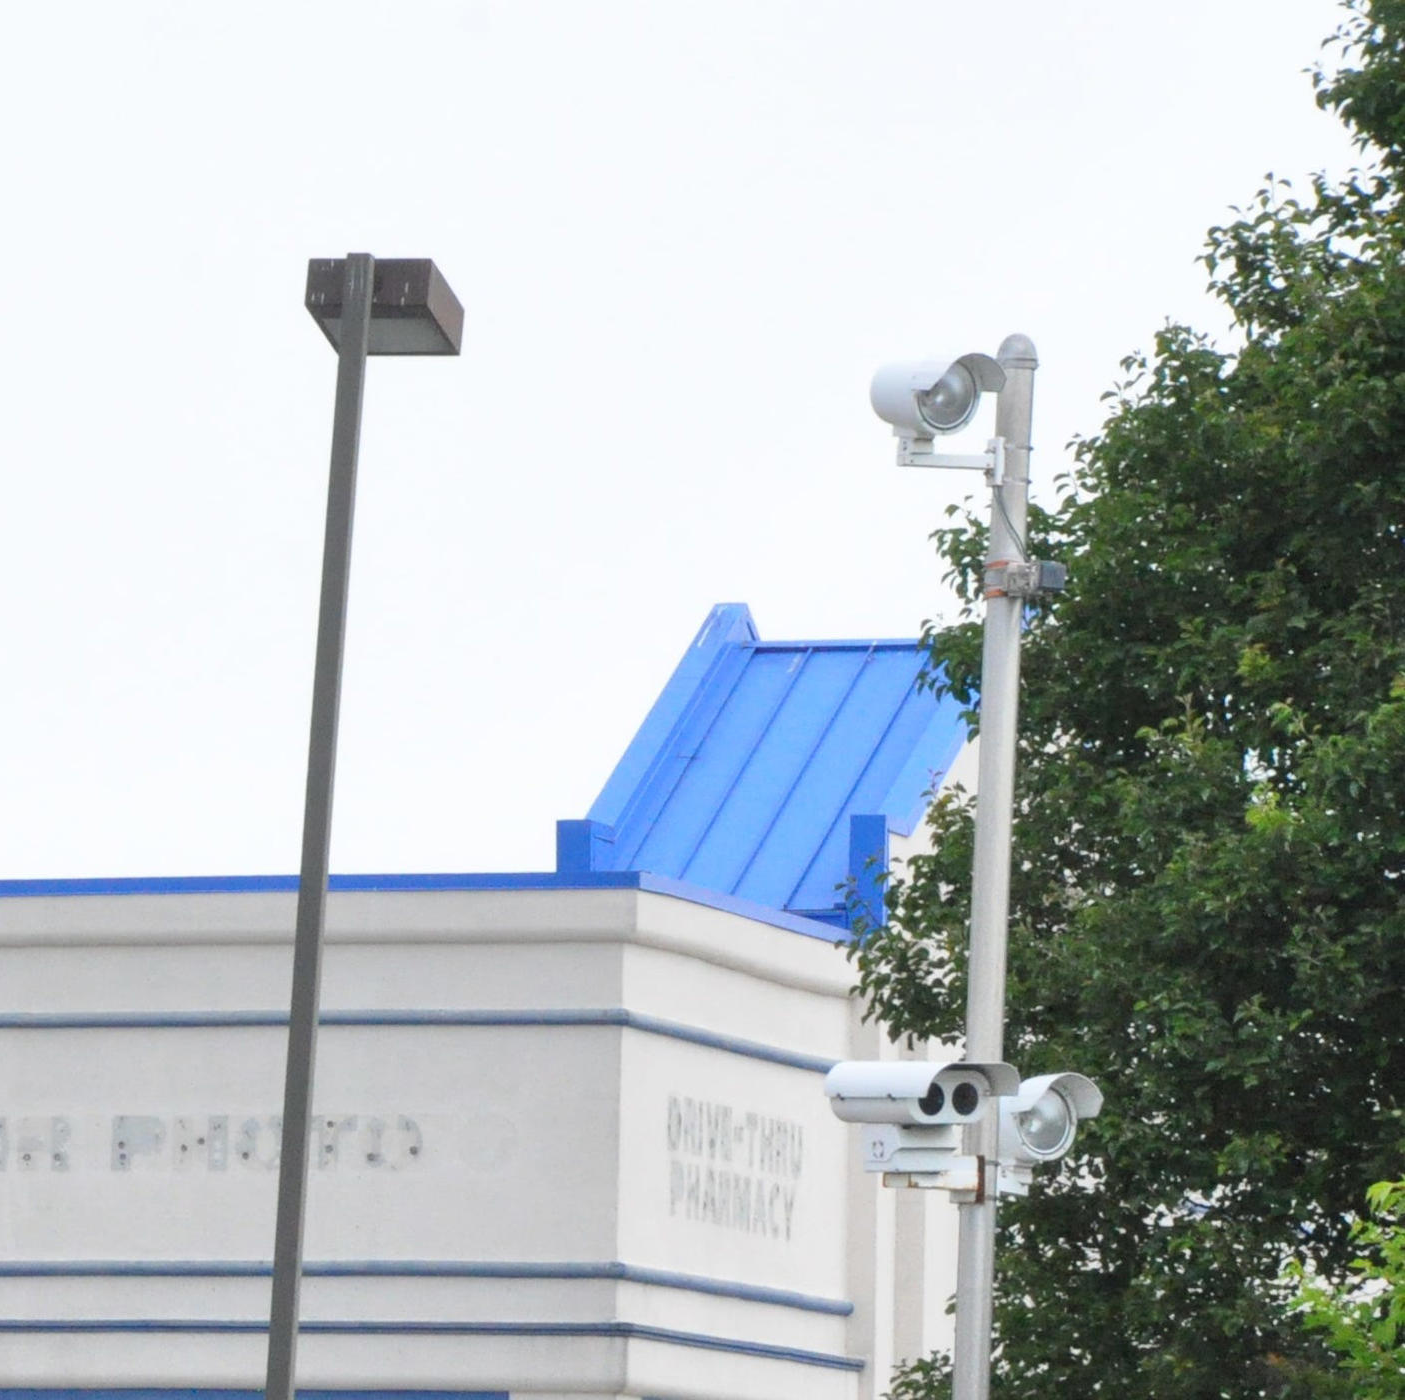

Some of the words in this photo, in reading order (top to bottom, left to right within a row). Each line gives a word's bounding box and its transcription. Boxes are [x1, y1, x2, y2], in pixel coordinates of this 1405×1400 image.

[110, 1114, 424, 1173] PHOTO
[666, 1095, 803, 1180] DRIVE-THRU
[668, 1159, 797, 1242] PHARMACY
